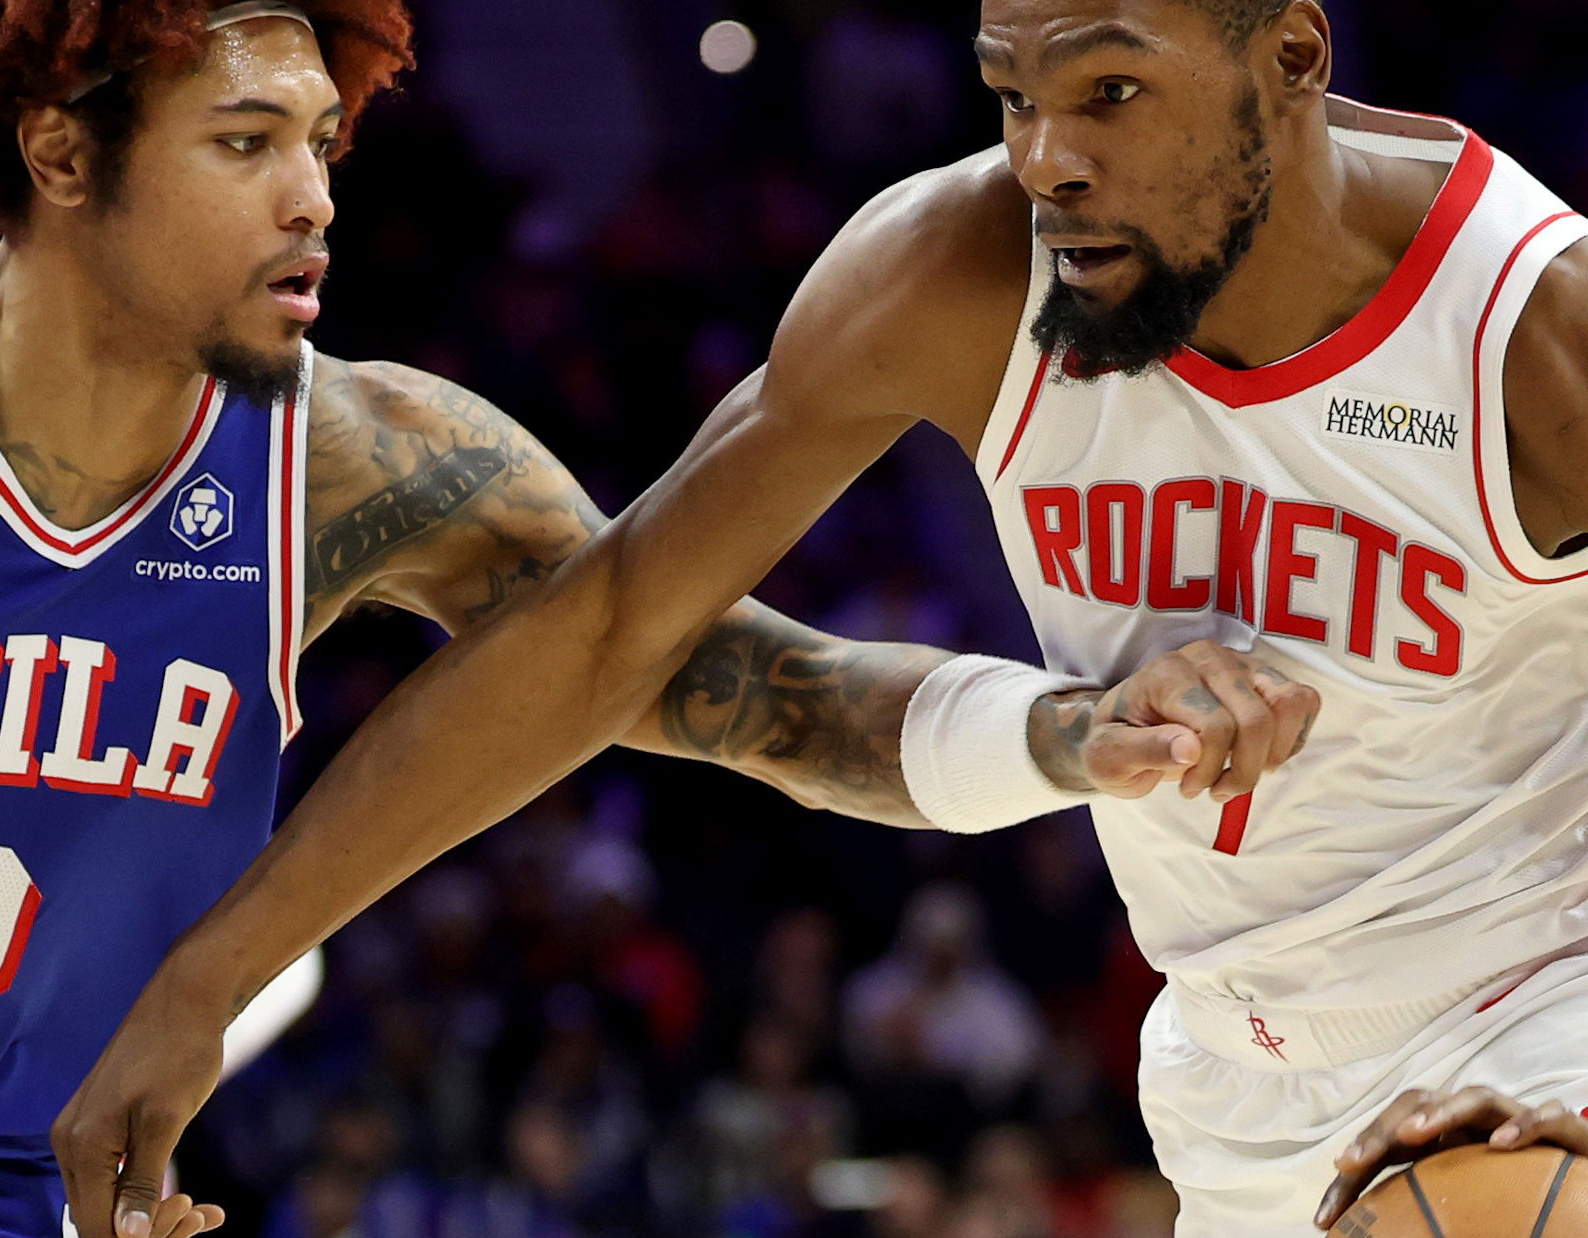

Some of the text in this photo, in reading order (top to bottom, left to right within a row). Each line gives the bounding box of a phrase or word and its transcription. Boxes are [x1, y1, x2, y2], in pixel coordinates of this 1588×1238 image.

[1325, 412, 1459, 451] HERMANN
[1327, 396, 1459, 433] MEMORIAL
[135, 559, 261, 583] crypto.com
[1019, 475, 1468, 680] ROCKETS
